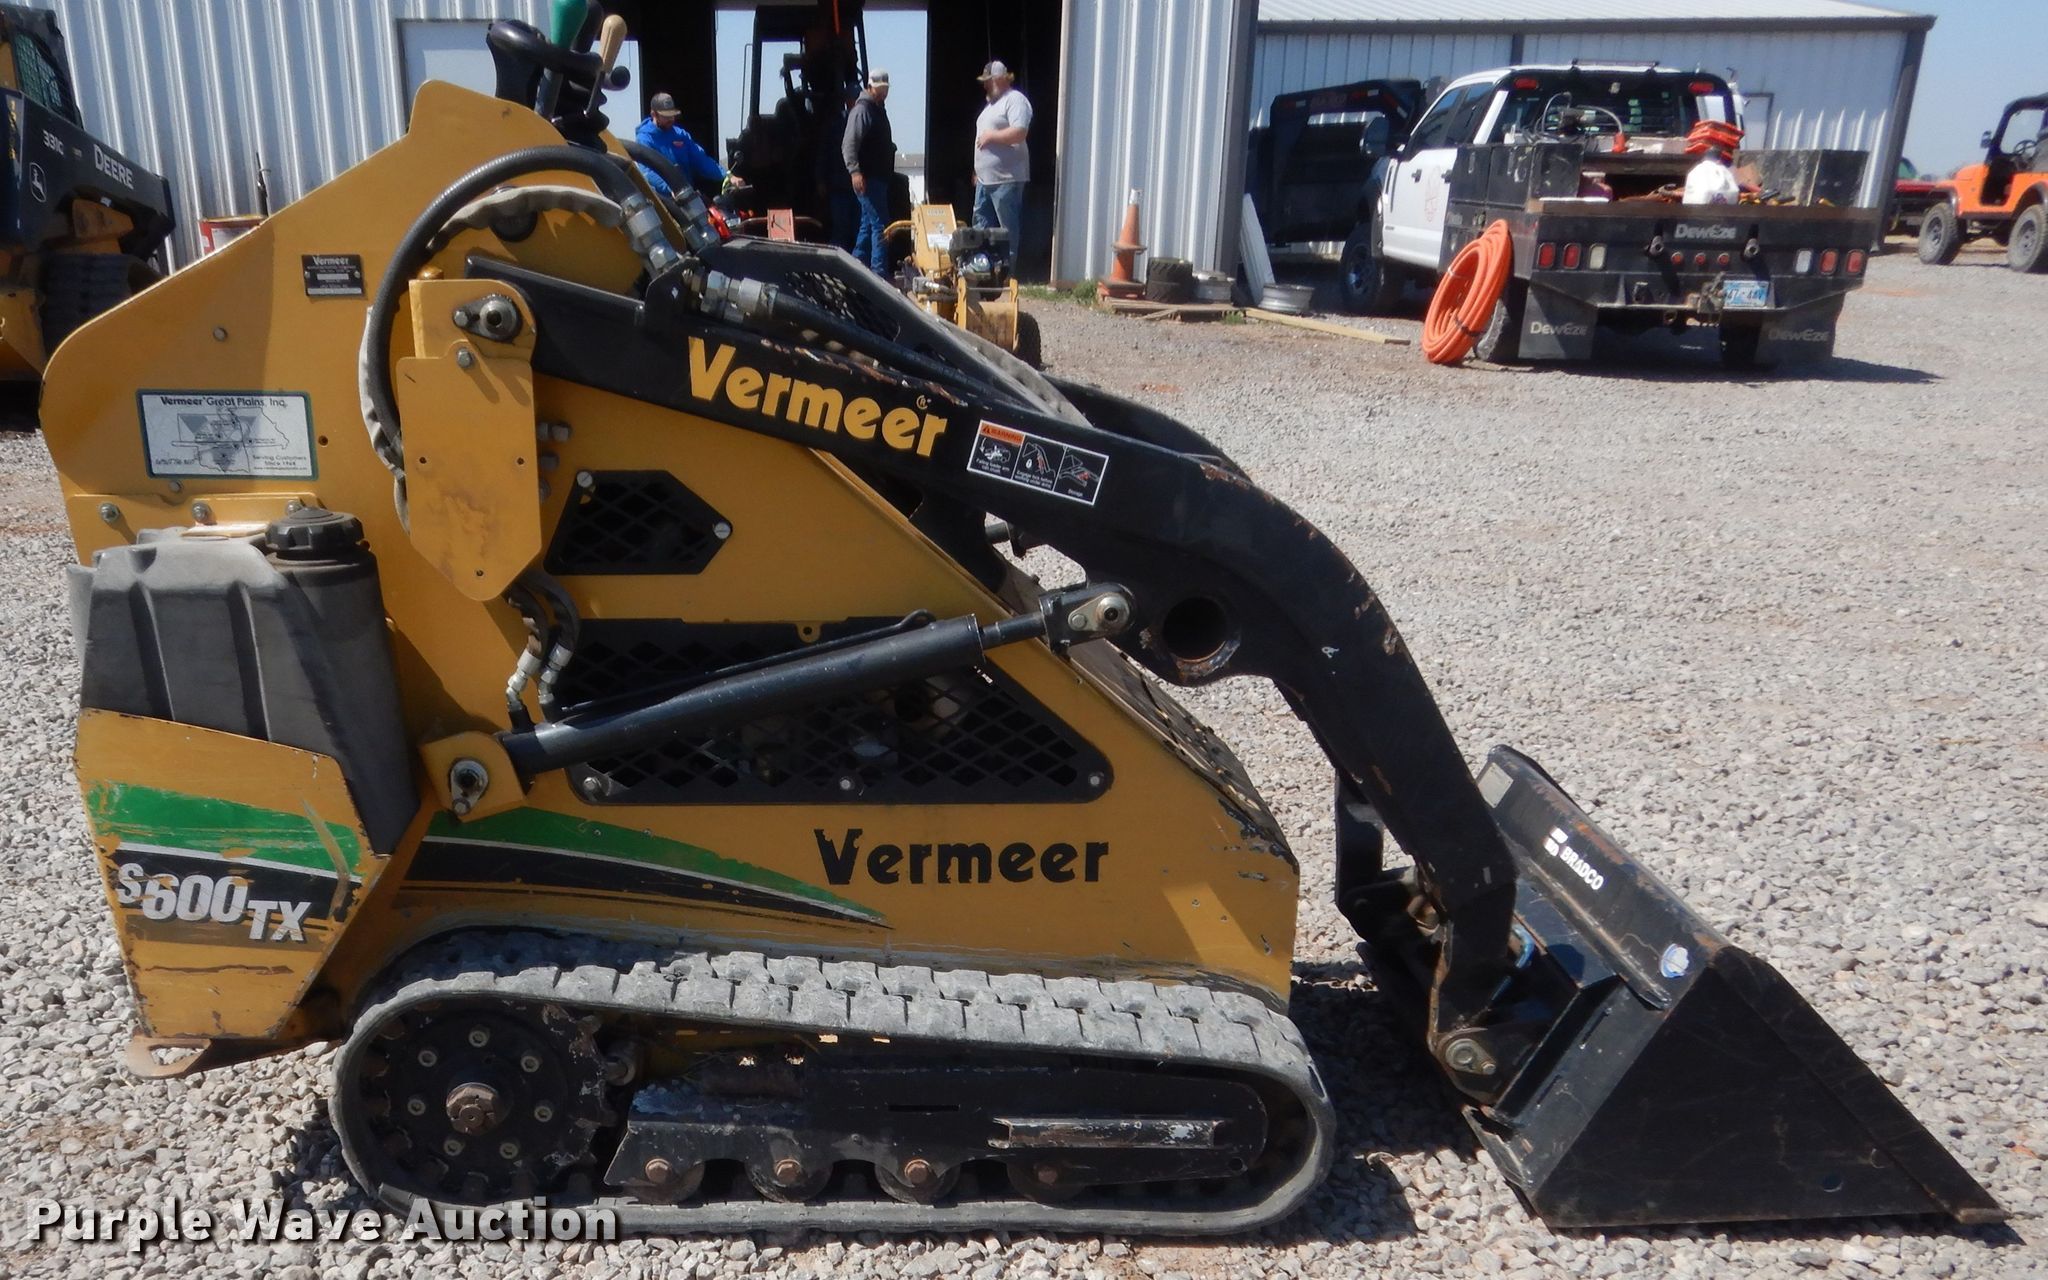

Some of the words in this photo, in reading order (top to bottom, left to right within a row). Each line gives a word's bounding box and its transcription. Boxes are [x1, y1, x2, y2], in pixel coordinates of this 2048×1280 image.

[93, 143, 134, 190] DEERE
[312, 255, 349, 266] Vermeer
[207, 397, 235, 407] Great
[688, 336, 948, 457] Vermeer
[814, 828, 1109, 885] Vermeer
[1559, 846, 1604, 890] BRADCO
